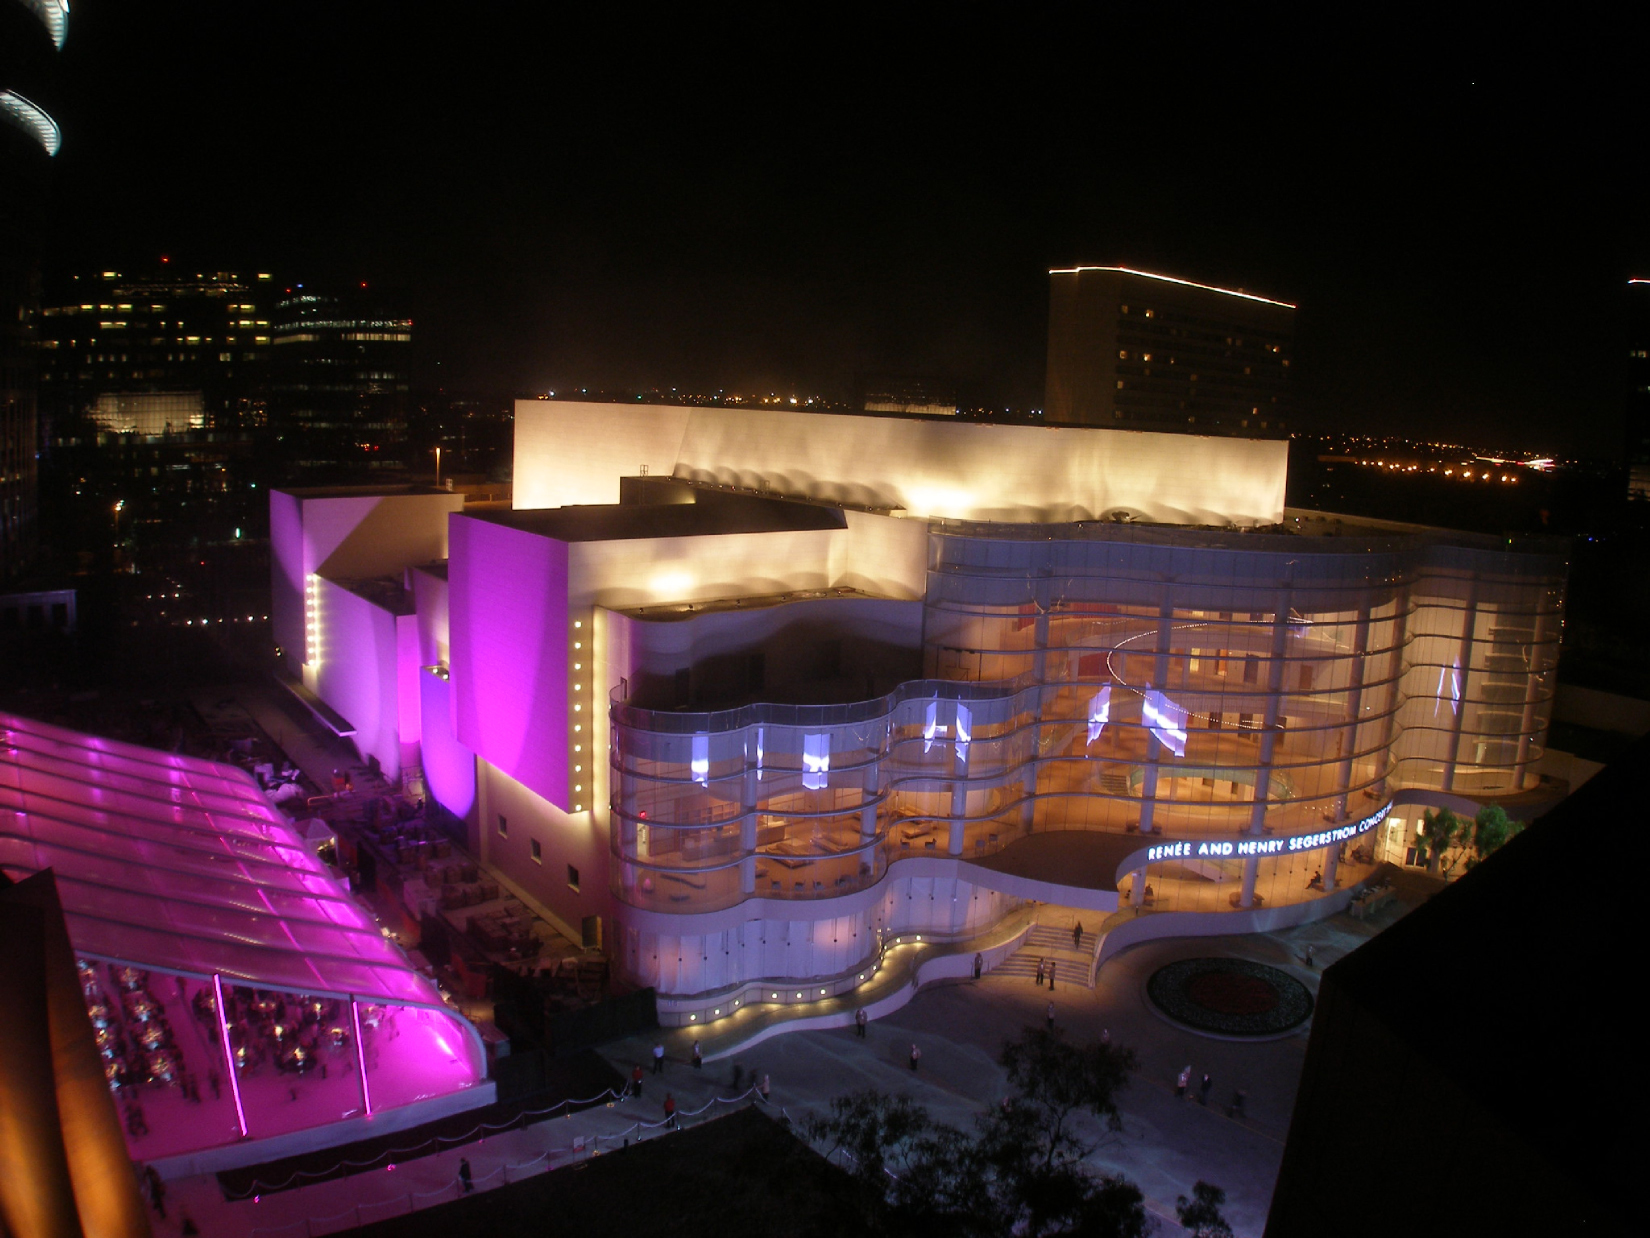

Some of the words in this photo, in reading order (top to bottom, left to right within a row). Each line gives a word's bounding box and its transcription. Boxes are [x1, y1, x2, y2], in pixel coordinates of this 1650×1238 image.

[1148, 841, 1191, 860] RENÉE
[1198, 842, 1233, 856] AND
[1237, 840, 1284, 855] HENRY
[1289, 825, 1357, 851] SEGERSTROM
